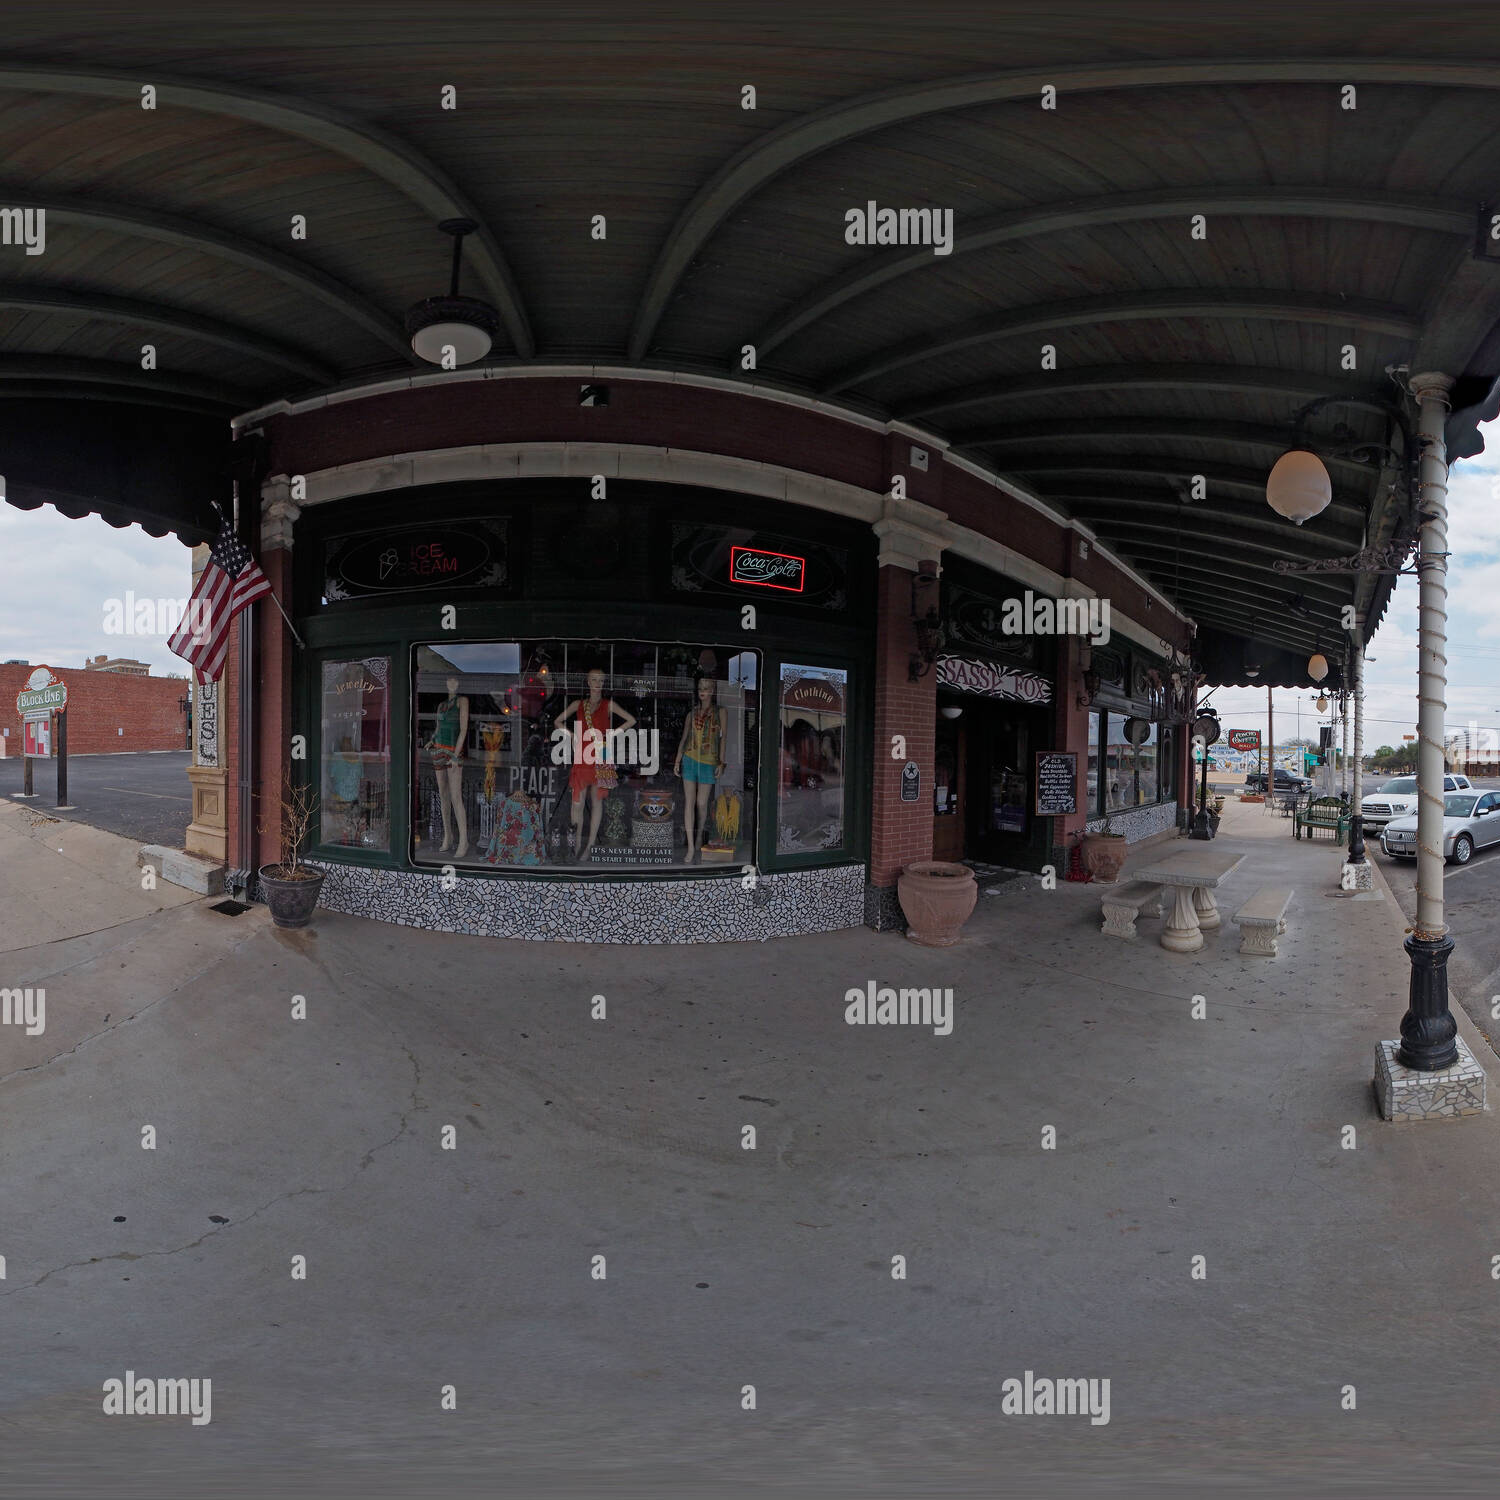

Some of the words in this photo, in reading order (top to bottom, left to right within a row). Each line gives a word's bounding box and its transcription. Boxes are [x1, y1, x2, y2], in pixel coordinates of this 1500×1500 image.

[410, 543, 444, 558] ICE
[397, 557, 458, 576] CREAM
[735, 552, 802, 578] Coca-Cola
[336, 679, 376, 696] Jewelry
[945, 658, 1002, 694] SASSY
[1014, 674, 1046, 699] FOX
[794, 686, 833, 704] Clothing
[510, 766, 557, 795] PEACE
